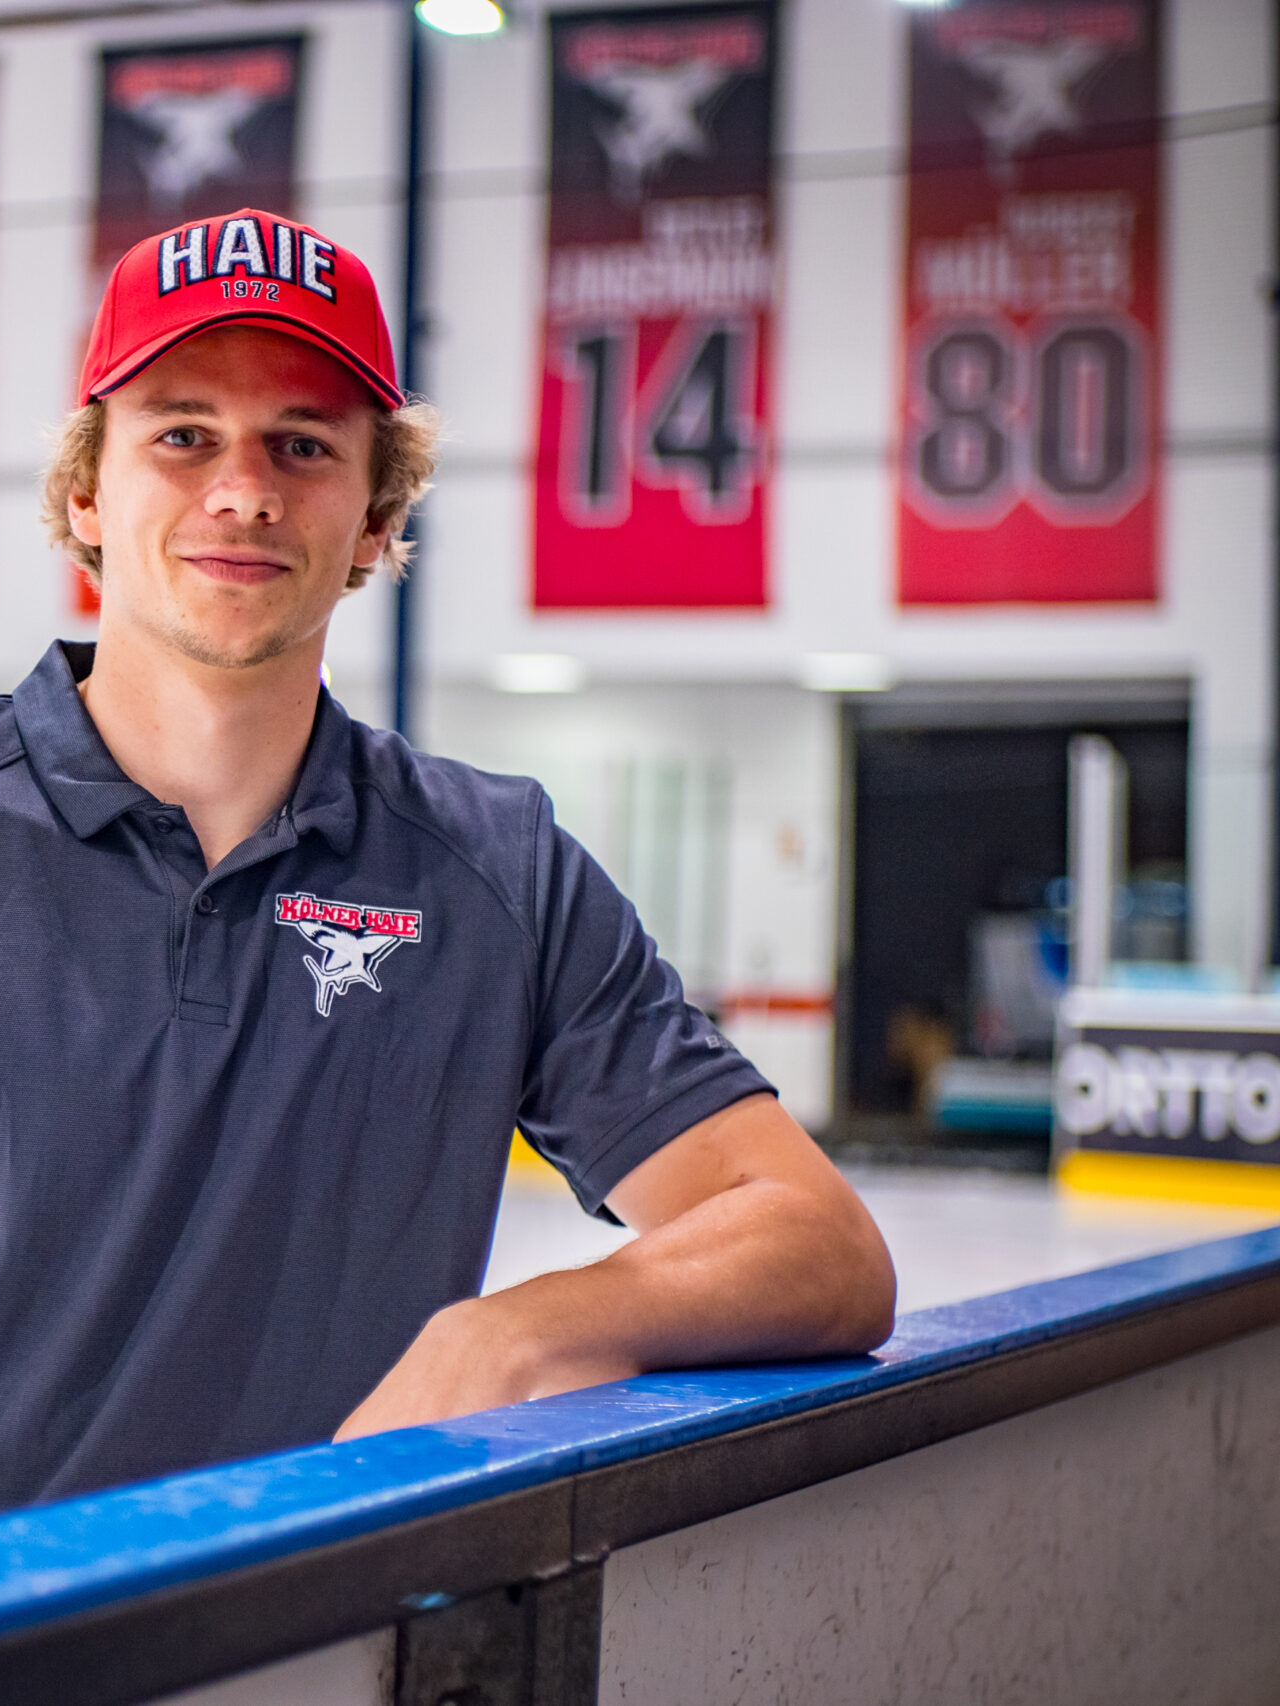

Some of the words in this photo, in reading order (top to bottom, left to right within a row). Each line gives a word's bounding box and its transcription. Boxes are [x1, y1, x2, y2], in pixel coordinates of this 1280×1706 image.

[158, 216, 337, 305] HAIE
[221, 280, 280, 302] 1972
[552, 320, 764, 522] 14
[908, 317, 1148, 524] 80
[279, 897, 361, 930] KÖLNER
[366, 910, 418, 937] HAIE
